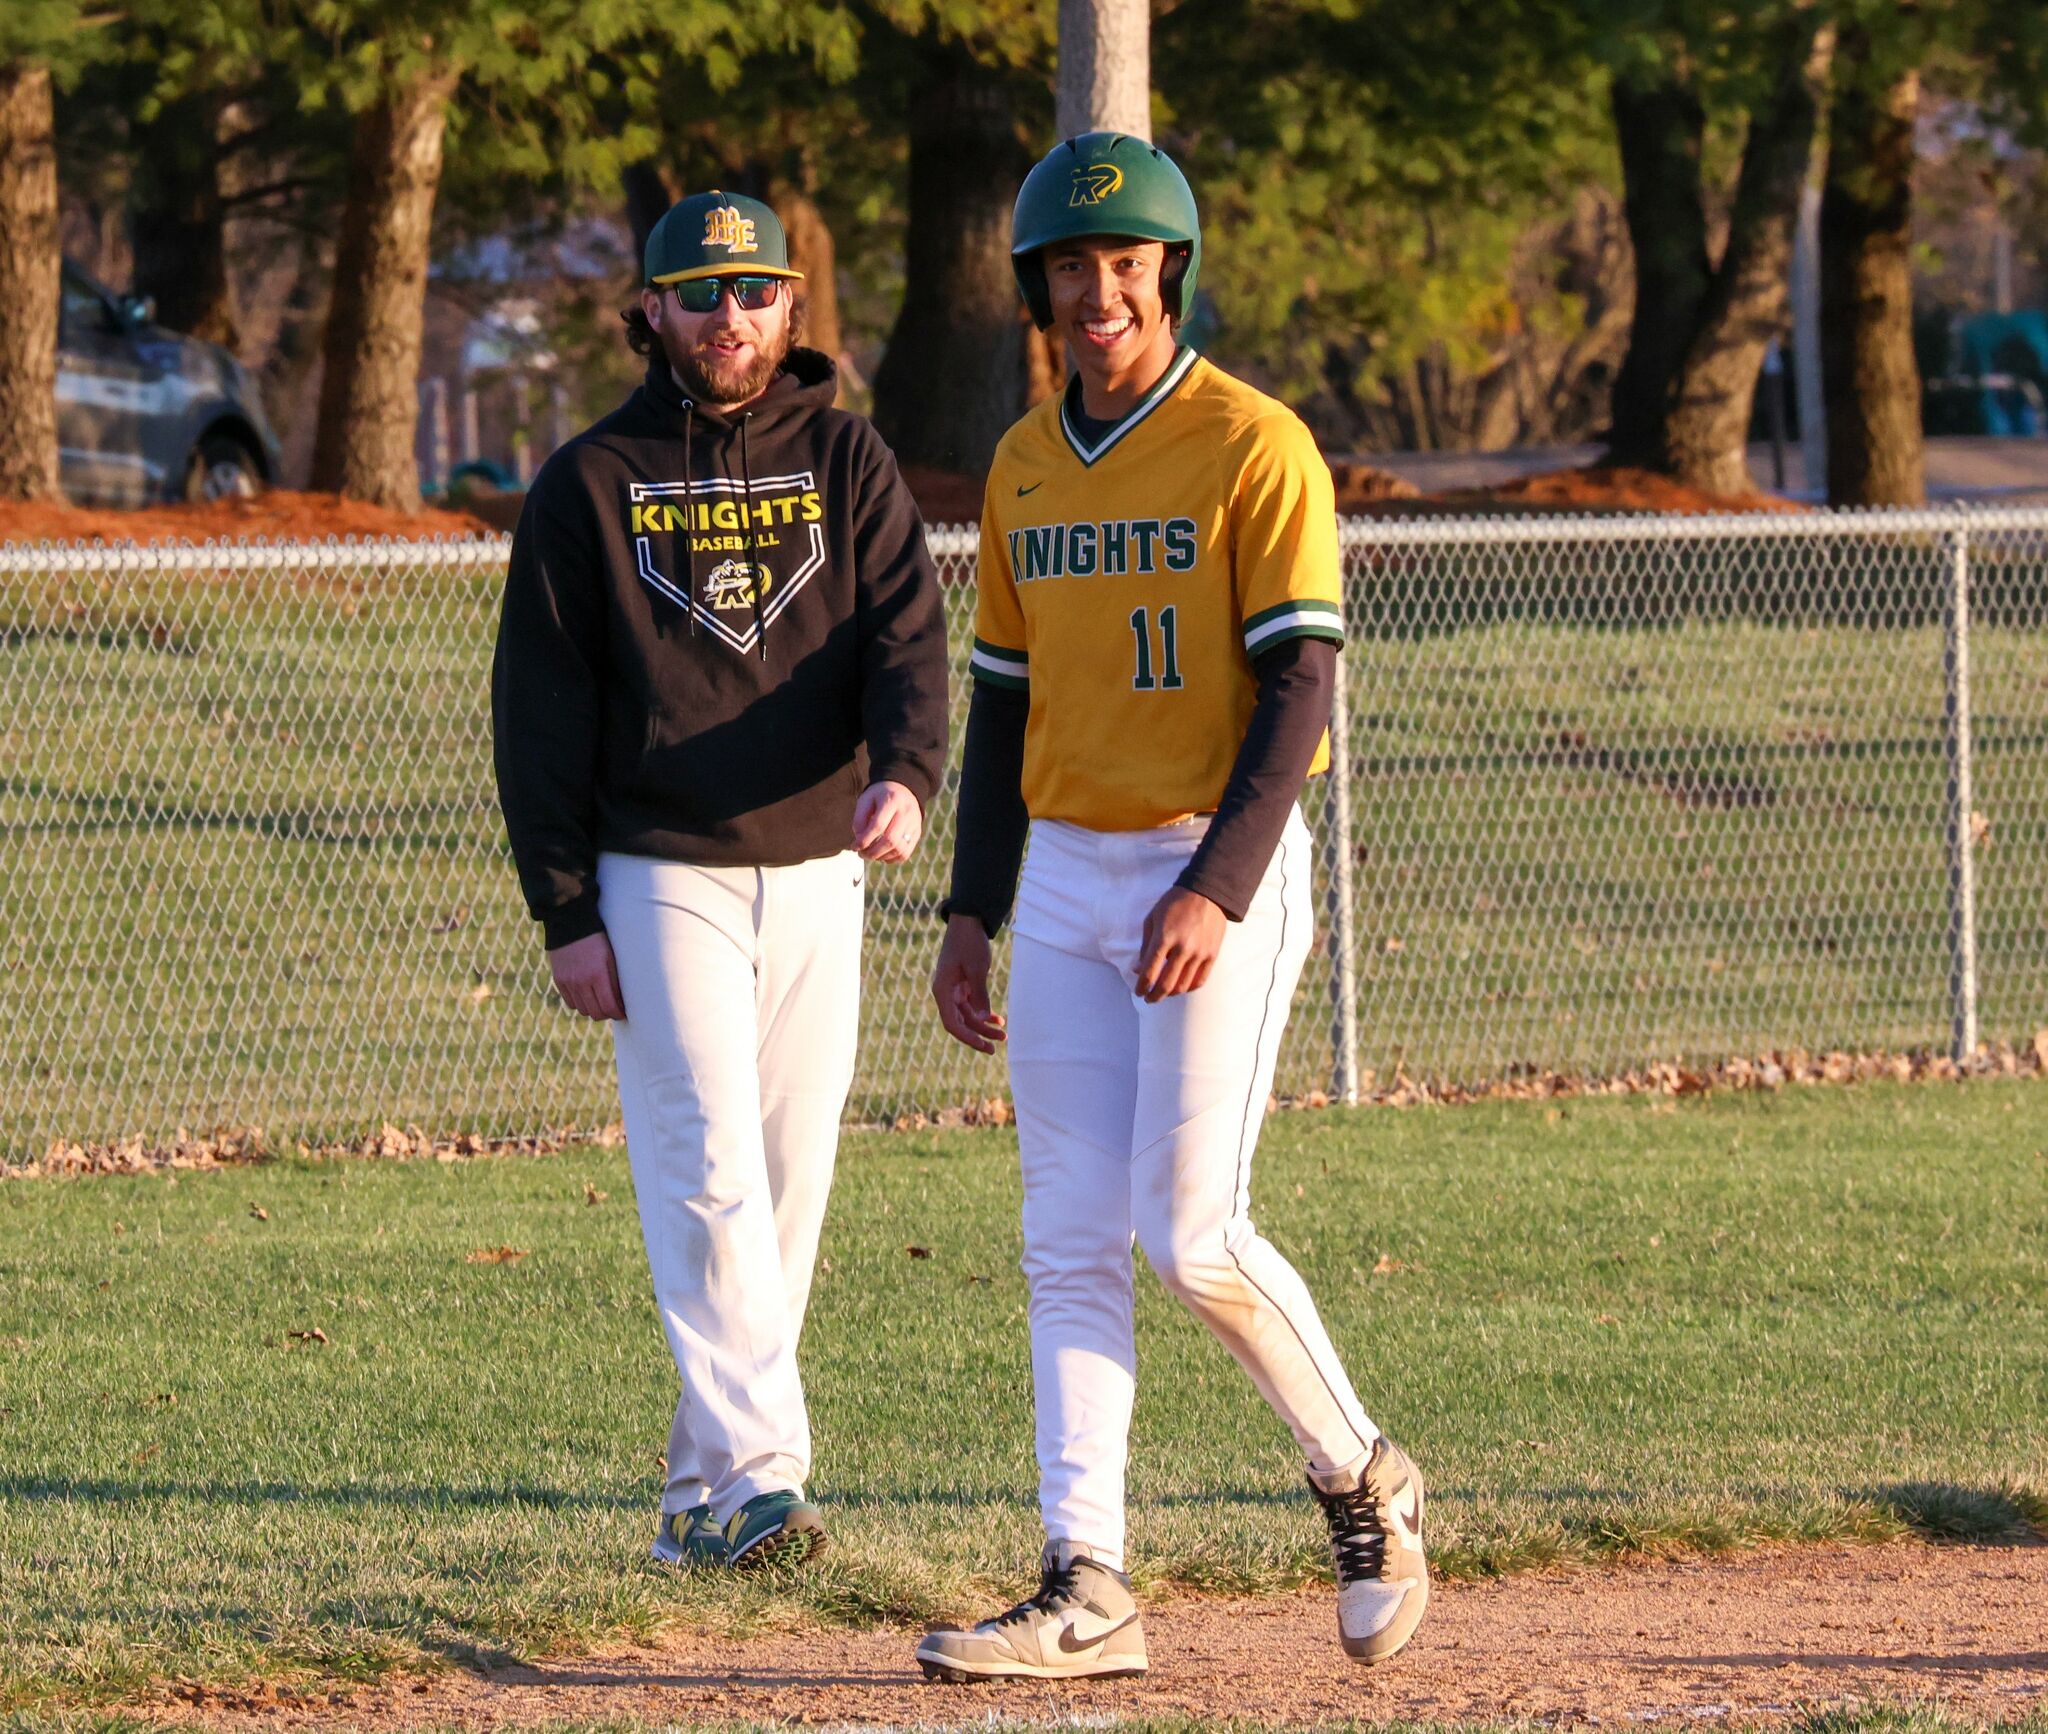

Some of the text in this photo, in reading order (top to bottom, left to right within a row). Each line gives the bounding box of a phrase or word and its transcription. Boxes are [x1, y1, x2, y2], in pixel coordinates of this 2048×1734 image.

[631, 492, 822, 533] KNIGHTS
[686, 532, 780, 551] BASEBALL
[1008, 517, 1196, 584] KNIGHTS
[1129, 605, 1184, 691] 11
